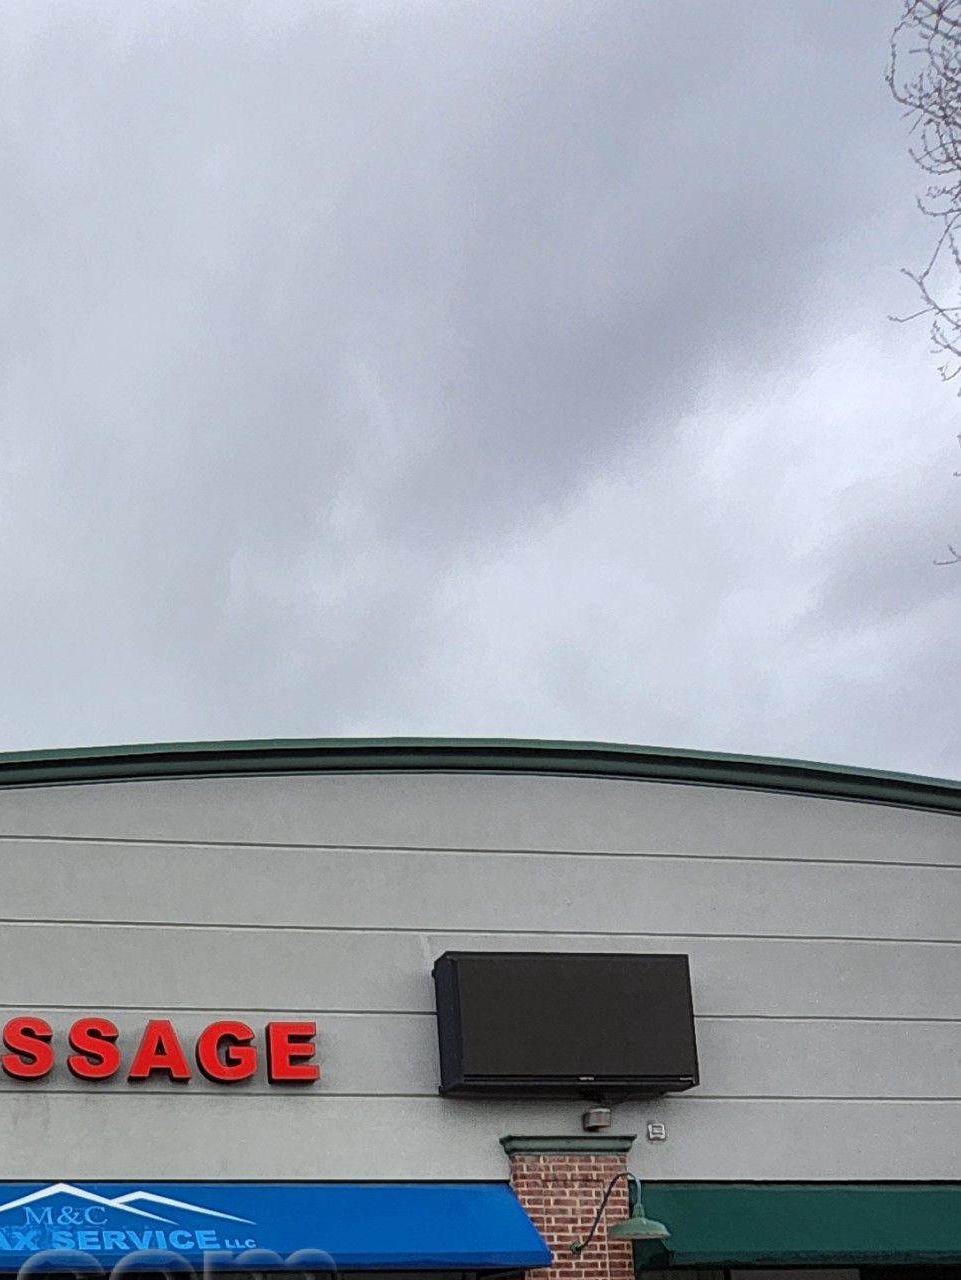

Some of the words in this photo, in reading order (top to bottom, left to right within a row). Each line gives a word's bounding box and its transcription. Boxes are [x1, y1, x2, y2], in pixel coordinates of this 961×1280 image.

[23, 1206, 108, 1226] M&C
[51, 1229, 220, 1251] SERVICE
[223, 1237, 257, 1249] LLC
